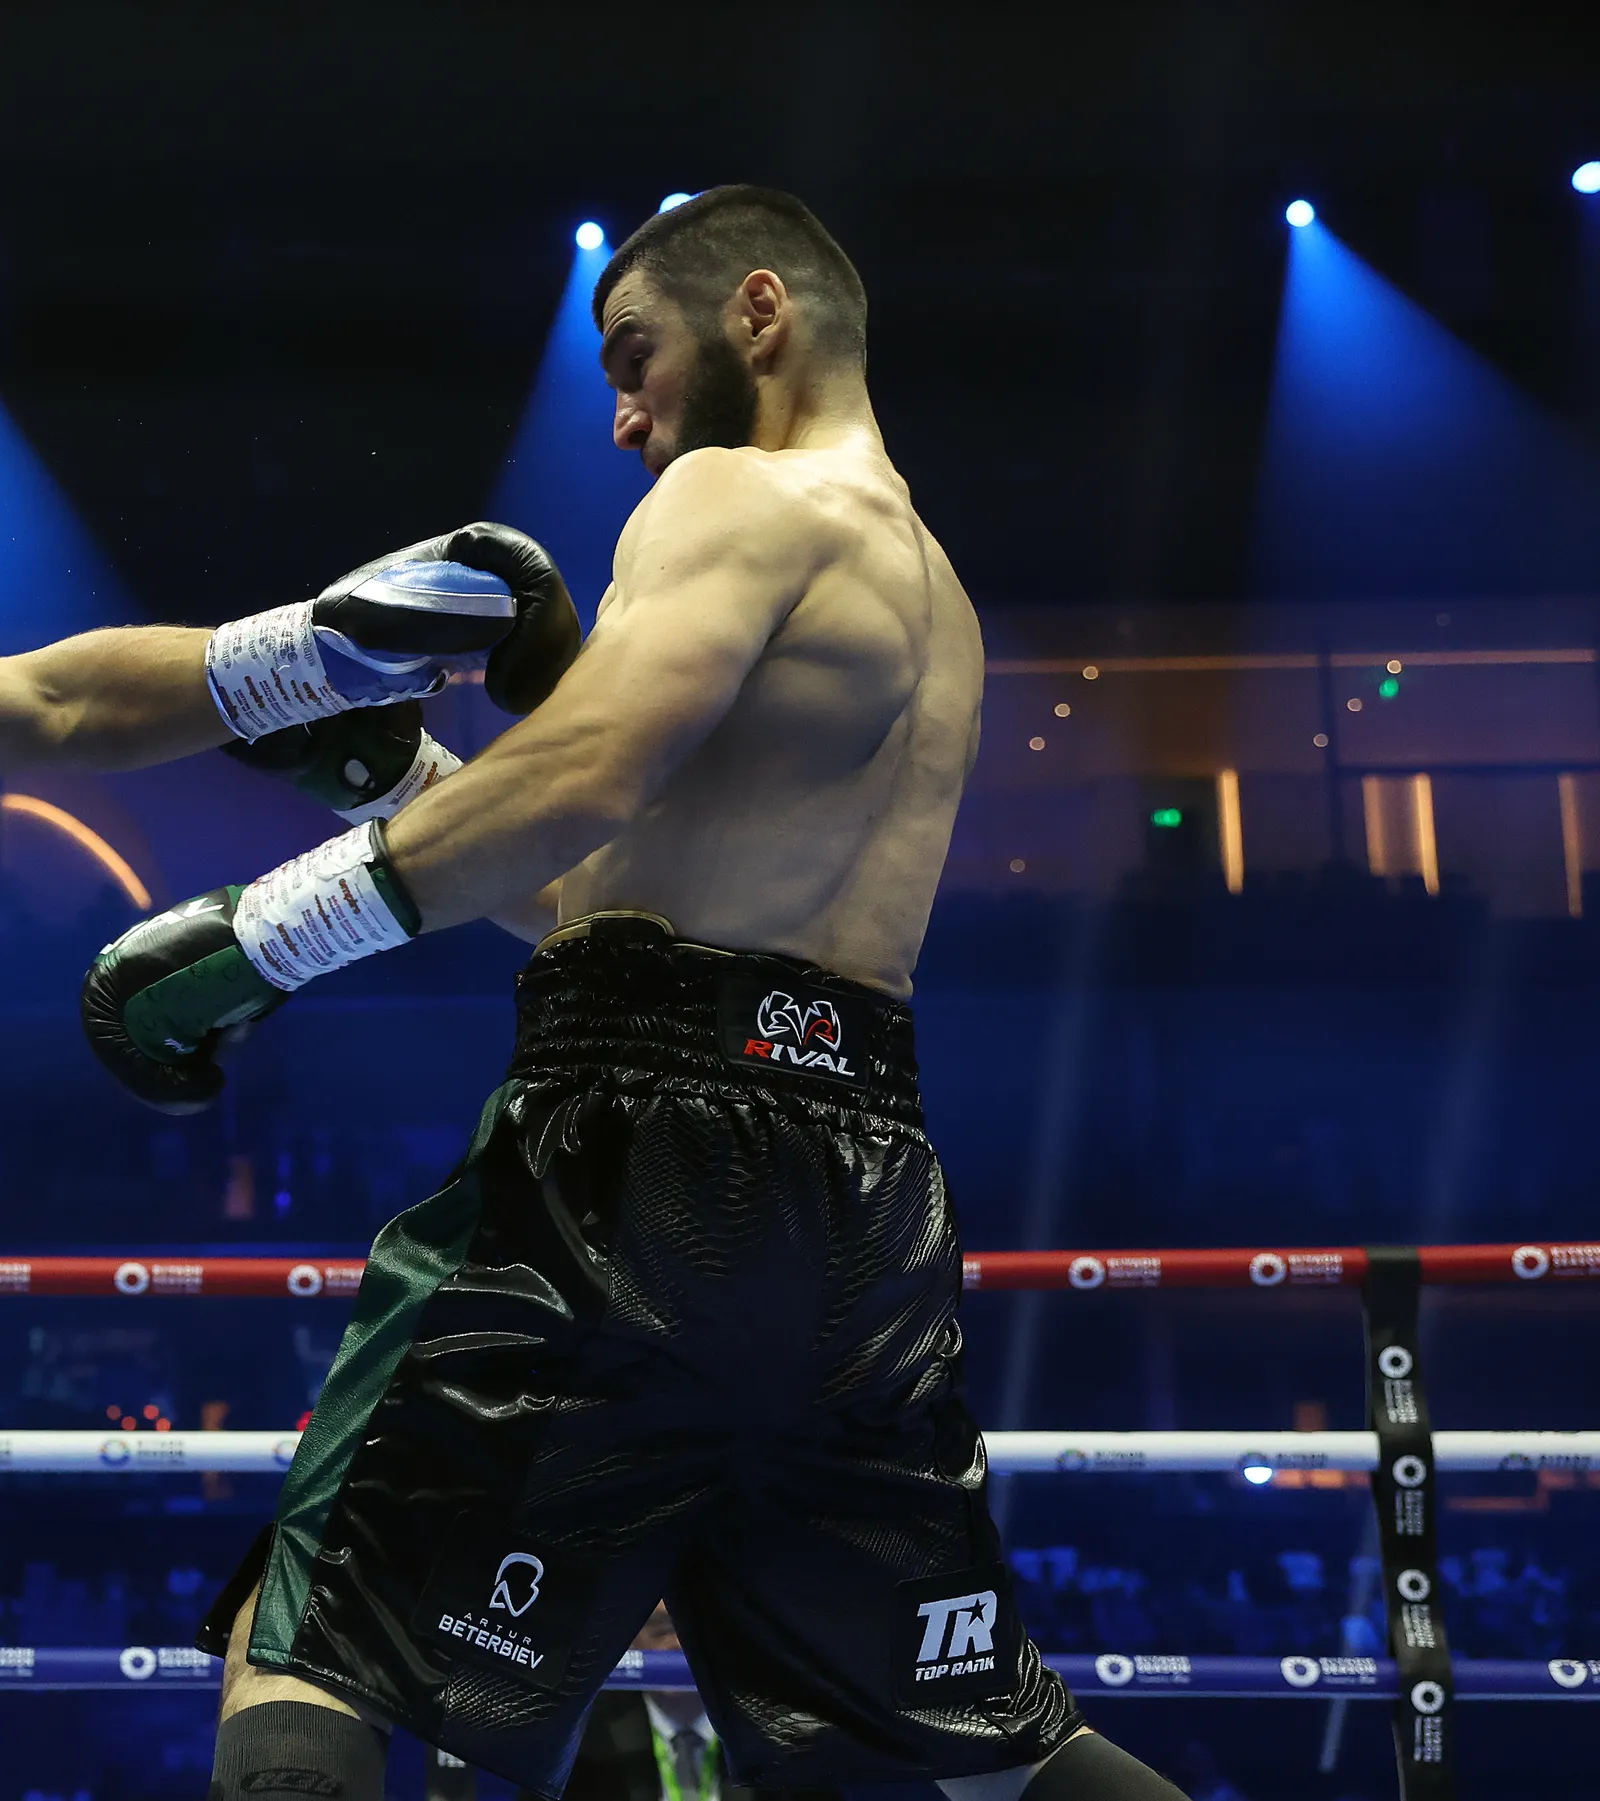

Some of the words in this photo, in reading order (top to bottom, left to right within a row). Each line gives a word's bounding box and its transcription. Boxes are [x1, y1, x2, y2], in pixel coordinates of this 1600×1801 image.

[743, 1038, 856, 1077] RIVAL
[438, 1613, 545, 1670] BETERBIEV
[463, 1612, 532, 1646] ARTUR
[915, 1664, 949, 1682] TOP
[950, 1655, 996, 1677] RANK
